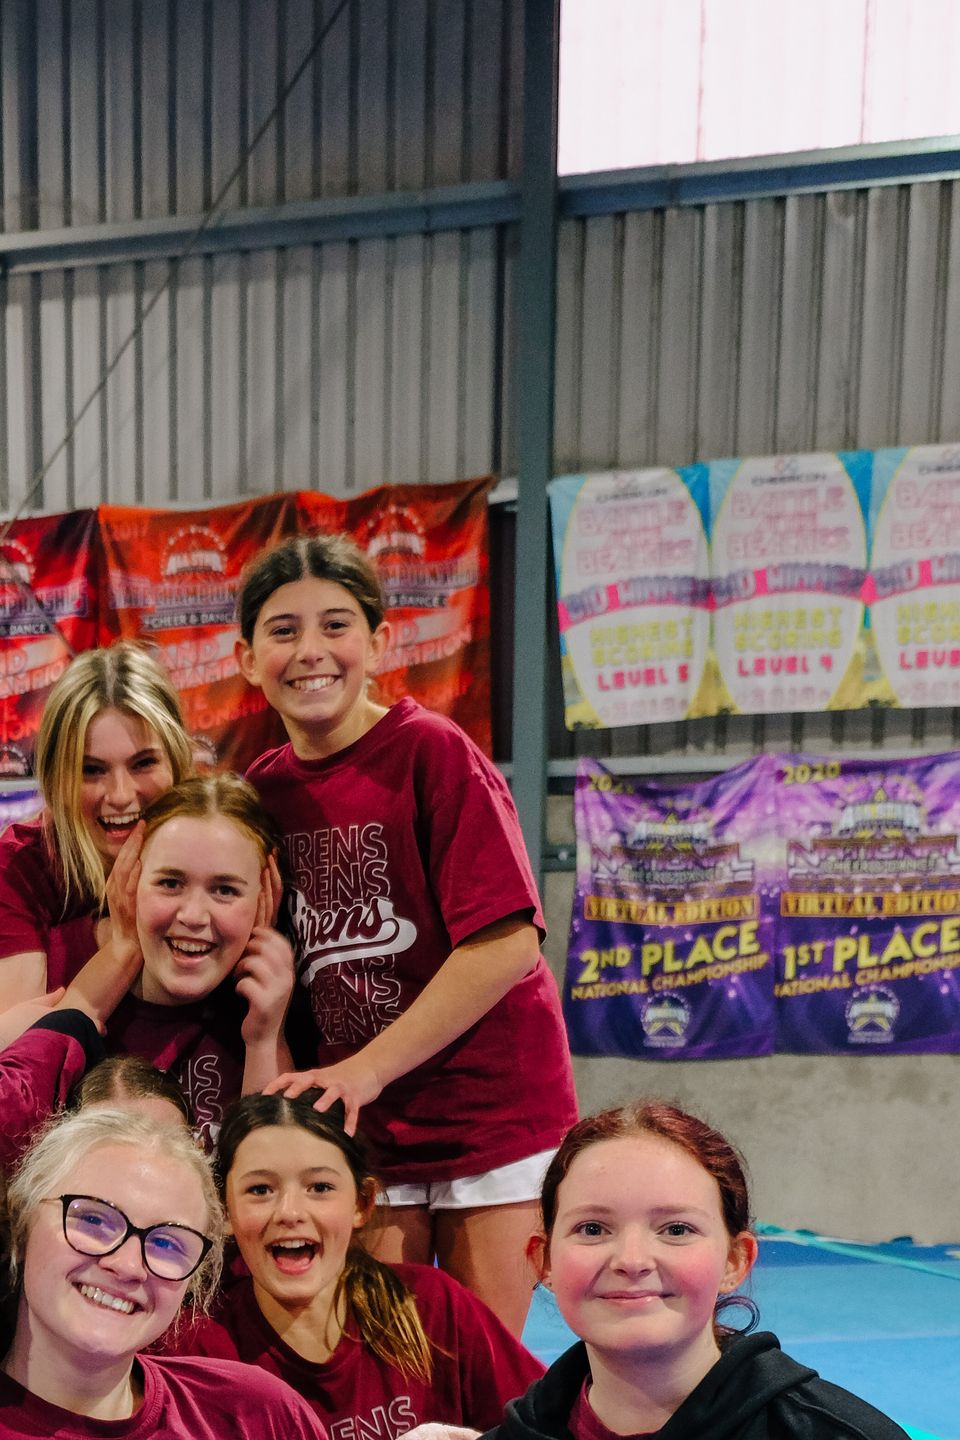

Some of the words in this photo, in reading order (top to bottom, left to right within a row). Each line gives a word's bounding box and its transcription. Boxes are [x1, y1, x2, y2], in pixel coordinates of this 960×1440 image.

[738, 655, 809, 677] LEVEL
[900, 650, 960, 671] LEVE
[597, 666, 668, 692] LEVEL
[784, 761, 840, 785] 2020
[577, 945, 631, 984] 2ND
[642, 920, 761, 976] PLACE
[783, 942, 826, 980] 1ST
[832, 917, 960, 972] PLACE
[571, 979, 649, 1000] NATIONAL
[652, 952, 770, 991] CHAMPIONSHIP
